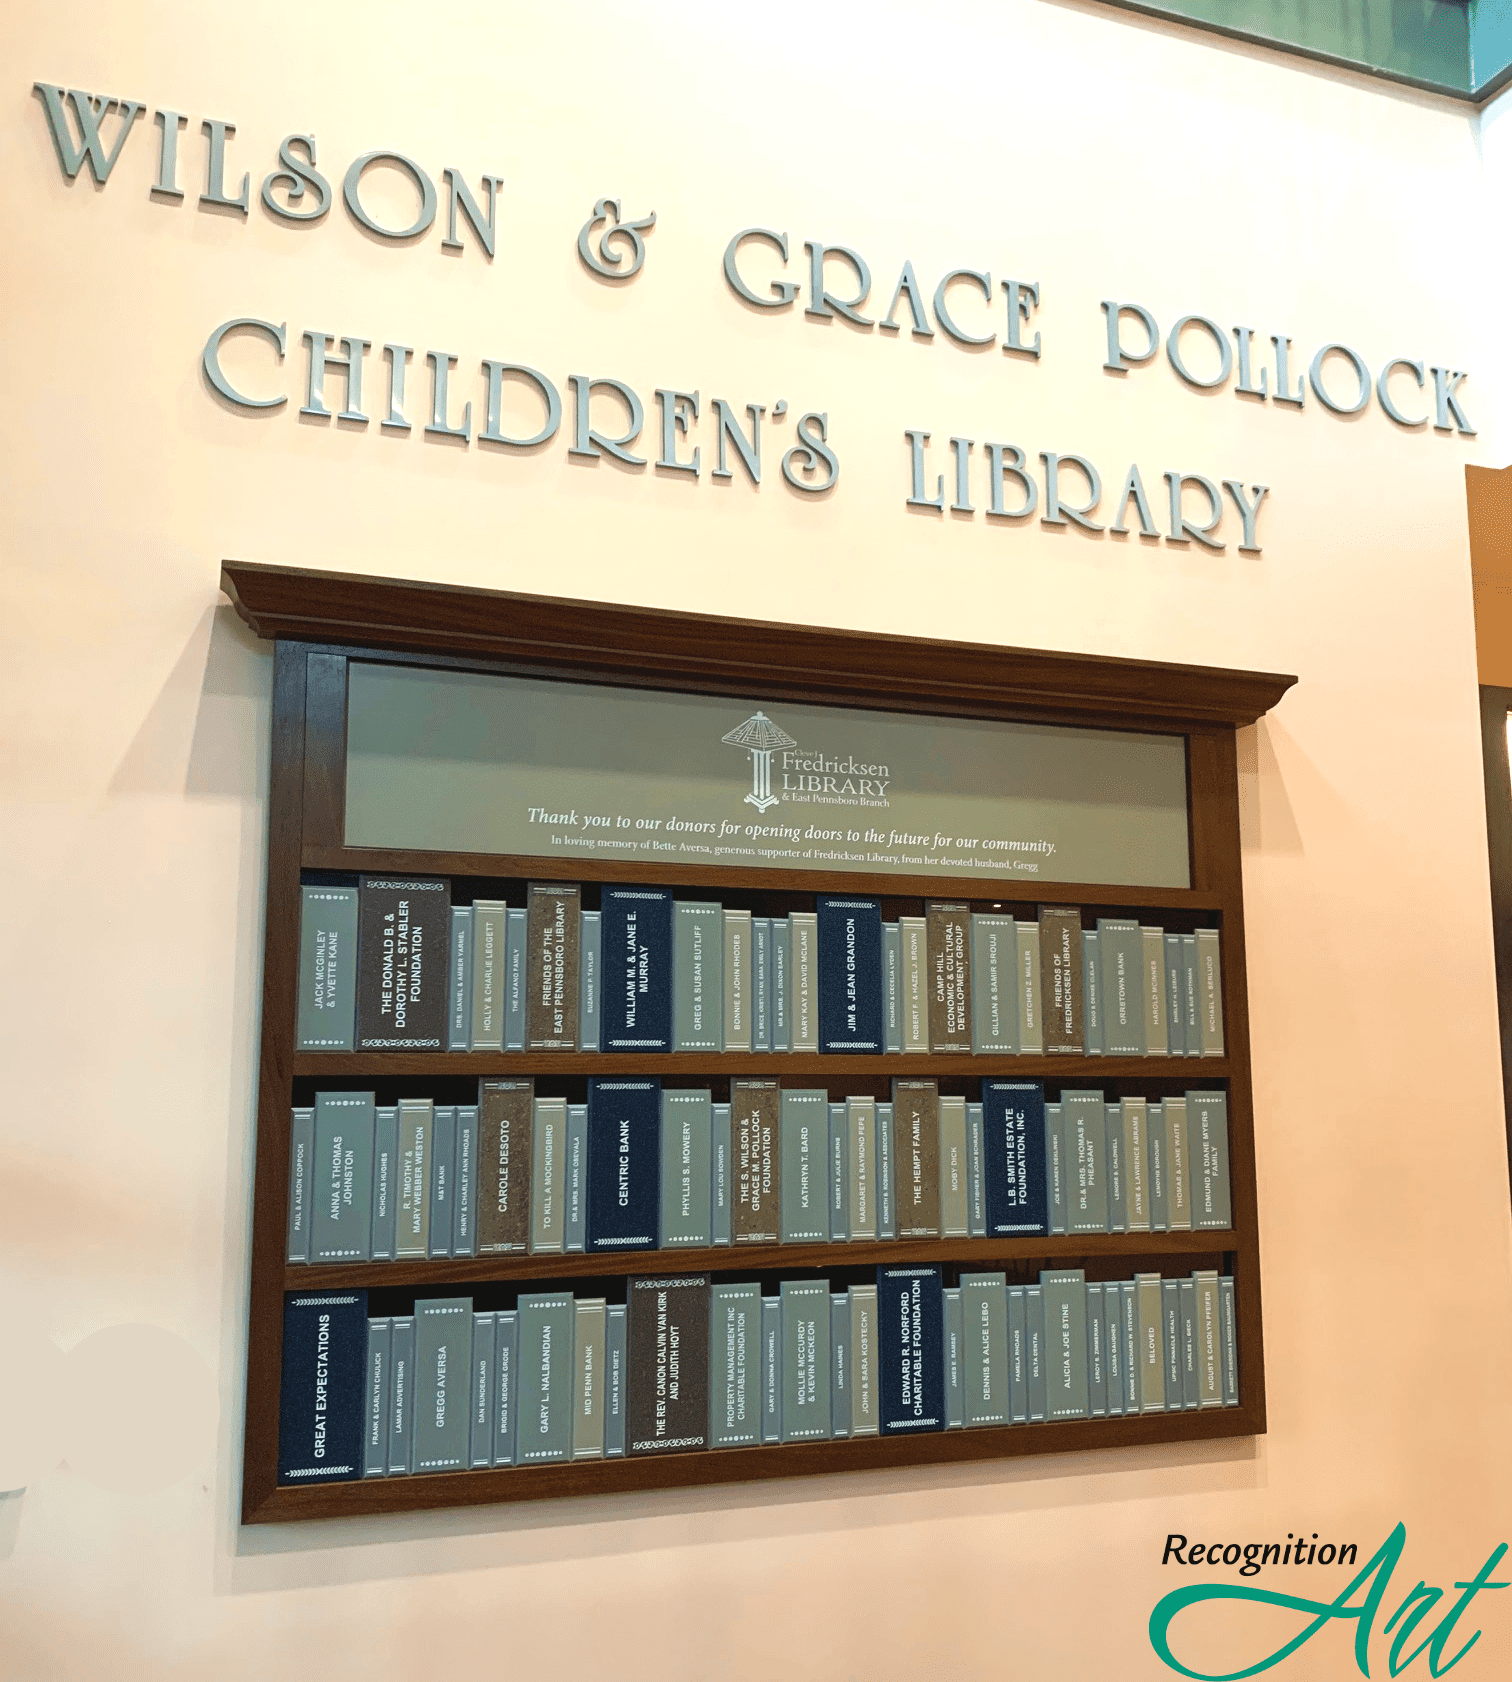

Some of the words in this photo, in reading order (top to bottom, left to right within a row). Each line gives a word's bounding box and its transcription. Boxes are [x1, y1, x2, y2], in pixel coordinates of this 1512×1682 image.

[32, 81, 504, 258] WILSON
[577, 197, 656, 280] &
[723, 228, 1042, 360] GRACE
[1100, 300, 1478, 436] POLLOCK
[202, 317, 840, 493] CHILDREN'S
[904, 429, 1270, 553] LIBRARY
[782, 751, 889, 777] Fredricksen
[781, 773, 891, 797] LIBRARY
[781, 792, 790, 801] &
[792, 793, 812, 803] East
[813, 794, 859, 805] Pennsboro
[860, 798, 890, 808] Branch
[528, 807, 578, 826] Thank
[582, 813, 611, 830] you
[616, 814, 631, 828] to
[635, 817, 662, 830] our
[666, 816, 716, 834] donors
[717, 819, 741, 838] for
[745, 823, 801, 843] opening
[804, 824, 843, 842] doors
[846, 828, 860, 842] to
[864, 828, 885, 843] the
[887, 829, 930, 848] future
[931, 831, 953, 850] for
[956, 836, 979, 849] our
[981, 838, 1057, 857] community.
[551, 834, 562, 845] In
[564, 835, 595, 849] loving
[597, 838, 638, 851] memory
[640, 840, 651, 850] of
[652, 840, 678, 851] Bette
[679, 842, 713, 854] Aversa,
[714, 846, 756, 857] generous
[757, 847, 801, 860] supporter
[802, 849, 813, 858] of
[814, 849, 865, 862] Fredricksen
[867, 852, 900, 866] Library,
[901, 854, 923, 866] from
[924, 855, 939, 866] her
[940, 856, 974, 868] devoted
[974, 858, 1012, 870] husband,
[1013, 860, 1039, 873] Gregg
[384, 925, 394, 935] B.
[398, 901, 409, 954] STABLER
[555, 901, 564, 942] LIBRARY
[627, 911, 636, 920] E.
[544, 928, 553, 946] THE
[627, 924, 636, 952] JANE
[846, 918, 855, 970] GRANDON
[946, 922, 954, 971] CULTURAL
[955, 926, 963, 958] GROUP
[1062, 928, 1071, 966] LIBRARY
[382, 940, 394, 988] DONALD
[397, 958, 407, 967] L.
[411, 927, 422, 1002] FOUNDATION
[544, 950, 552, 962] OF
[627, 967, 636, 978] M.
[639, 946, 648, 992] MURRAY
[936, 952, 944, 972] HILL
[1053, 954, 1061, 966] OF
[542, 965, 552, 1006] FRIENDS
[554, 946, 564, 1005] PENNSBORO
[694, 963, 702, 993] SUSAN
[847, 974, 856, 1001] JEAN
[936, 975, 944, 1002] CAMP
[1053, 969, 1062, 1007] FRIENDS
[382, 992, 392, 1014] THE
[396, 971, 407, 1028] DOROTHY
[627, 982, 636, 1028] WILLIAM
[946, 983, 955, 1033] ECONOMIC
[956, 961, 964, 1030] DEVELOPMENT
[1063, 970, 1073, 1034] FREDRICKSEN
[1118, 978, 1126, 1024] ORRSTOWN
[554, 1009, 563, 1033] EAST
[694, 1005, 702, 1030] GREG
[847, 1015, 856, 1031] JIM
[620, 1120, 629, 1152] BANK
[752, 1110, 760, 1158] POLLOCK
[912, 1112, 921, 1146] FAMILY
[1005, 1108, 1015, 1148] ESTATE
[1017, 1110, 1025, 1130] INC.
[332, 1136, 342, 1178] THOMAS
[499, 1121, 509, 1164] DESOTO
[544, 1124, 553, 1185] MOCKINGBIRD
[682, 1122, 690, 1163] MOWERY
[741, 1129, 749, 1168] WILSON
[380, 1153, 388, 1180] HUGHES
[682, 1166, 690, 1174] S.
[741, 1171, 749, 1180] S.
[752, 1162, 760, 1172] M.
[763, 1127, 771, 1193] FOUNDATION
[913, 1150, 921, 1182] HEMPT
[1006, 1152, 1016, 1183] SMITH
[1017, 1133, 1027, 1204] FOUNDATION,
[343, 1151, 354, 1205] JOHNSTON
[498, 1168, 508, 1212] CAROLE
[619, 1156, 629, 1206] CENTRIC
[741, 1183, 749, 1203] THE
[752, 1176, 760, 1211] GRACE
[331, 1191, 340, 1220] ANNA
[379, 1183, 387, 1216] NICHOLAS
[682, 1178, 690, 1216] PHYLLIS
[913, 1186, 921, 1205] THE
[1007, 1187, 1016, 1206] L.B.
[544, 1217, 551, 1228] TO
[658, 1292, 668, 1312] KIRK
[901, 1292, 910, 1343] NORFORD
[912, 1280, 921, 1346] FOUNDATION
[658, 1314, 667, 1331] VAN
[670, 1326, 679, 1348] HOYT
[738, 1313, 746, 1366] FOUNDATION
[316, 1315, 330, 1410] EXPECTATIONS
[541, 1326, 551, 1390] NALBANDIAN
[585, 1345, 593, 1370] BANK
[657, 1334, 667, 1363] CALVIN
[670, 1351, 679, 1380] JUDITH
[727, 1324, 735, 1381] MANAGEMENT
[902, 1346, 910, 1356] R.
[396, 1361, 404, 1406] ADVERTISING
[437, 1346, 447, 1387] AVERSA
[657, 1366, 666, 1396] CANON
[902, 1359, 910, 1404] EDWARD
[913, 1350, 922, 1416] CHARITABLE
[541, 1394, 550, 1402] L.
[584, 1373, 592, 1396] PENN
[670, 1382, 679, 1400] AND
[737, 1368, 745, 1420] CHARITABLE
[436, 1391, 445, 1427] GREGG
[540, 1405, 550, 1433] GARY
[584, 1399, 592, 1415] MID
[656, 1398, 666, 1417] REV.
[727, 1384, 735, 1427] PROPERTY
[315, 1415, 326, 1458] GREAT
[656, 1419, 666, 1436] THE
